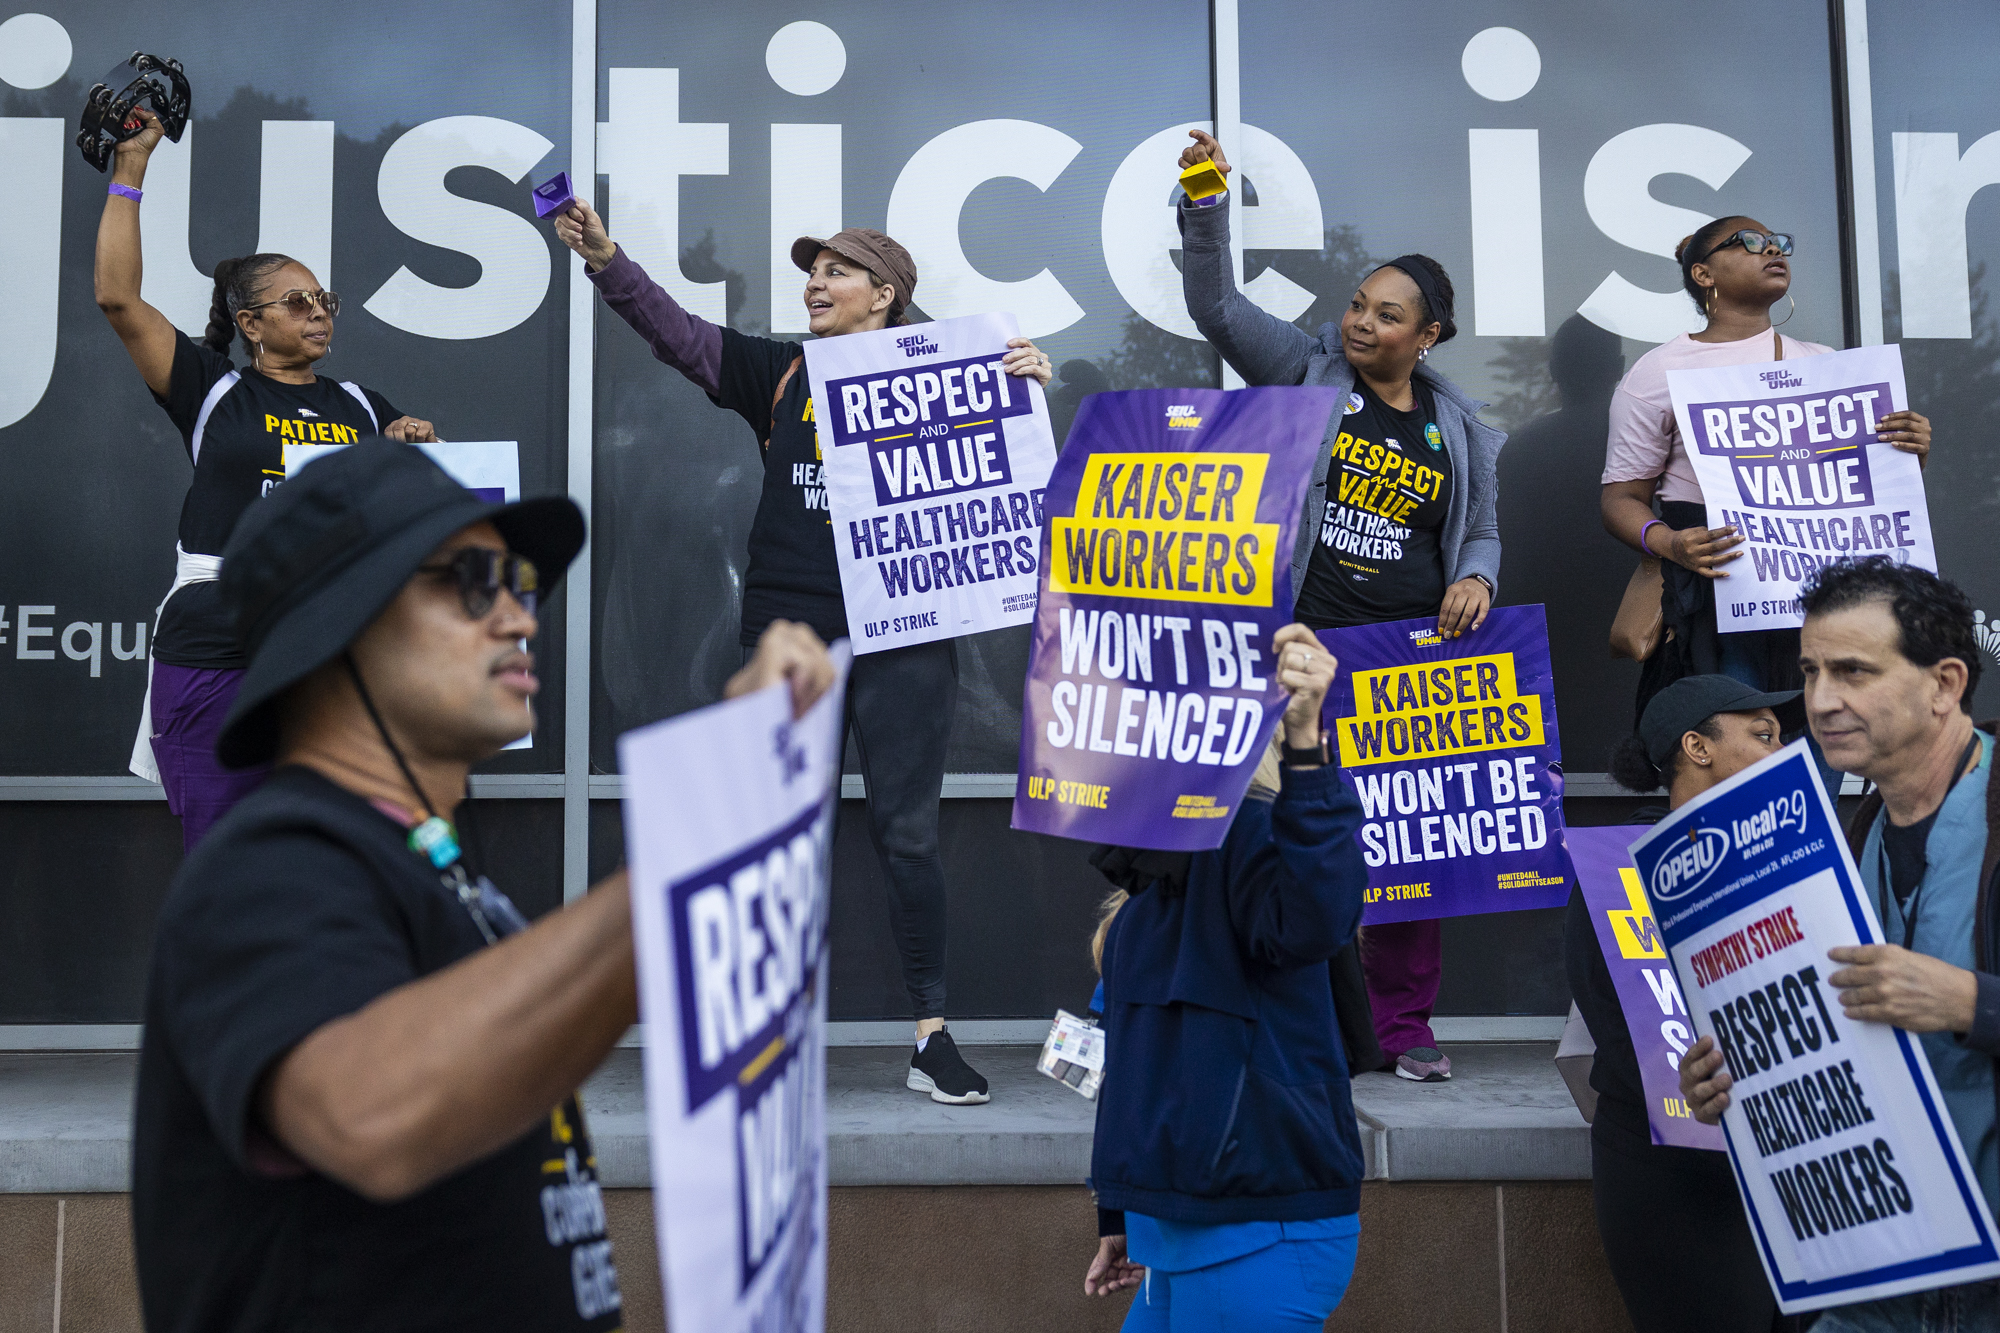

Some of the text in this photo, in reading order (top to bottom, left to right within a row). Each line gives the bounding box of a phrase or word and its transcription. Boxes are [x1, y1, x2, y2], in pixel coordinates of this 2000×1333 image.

[0, 13, 1324, 429] justice
[1461, 26, 1753, 343] is
[896, 334, 928, 349] SEIU-
[905, 343, 938, 358] UHW
[841, 360, 1011, 434] RESPECT
[1759, 370, 1792, 382] SEIU-
[1768, 377, 1803, 390] UHW
[265, 413, 359, 444] PATIENT
[919, 423, 949, 439] AND
[1165, 405, 1196, 417] SEIU-
[1168, 416, 1202, 428] UHW
[1702, 390, 1880, 449] RESPECT
[876, 432, 1003, 498] VALUE
[1331, 432, 1444, 501] RESPECT
[1780, 448, 1810, 461] AND
[1092, 462, 1243, 523] KAISER
[1338, 472, 1418, 524] VALUE
[1371, 475, 1399, 490] and
[1737, 457, 1866, 506] VALUE
[849, 488, 1047, 559] HEALTHCARE
[1320, 523, 1403, 560] WORKERS
[1324, 500, 1412, 541] EALTHCARE
[1721, 510, 1916, 552] HEALTHCARE
[878, 536, 1037, 599] WORKERS
[1064, 527, 1259, 596] WORKERS
[864, 611, 938, 638] ULP STRIKE
[1409, 629, 1435, 640] SEIU-
[1731, 602, 1757, 618] ULP
[0, 605, 160, 678] Equ
[1059, 607, 1267, 692] WON'T BE
[1416, 636, 1442, 646] UHW
[1369, 661, 1501, 714] KAISER
[1046, 681, 1264, 766] SILENCED
[1349, 702, 1531, 760] WORKERS
[1028, 776, 1111, 810] ULP STRIKE
[1354, 756, 1541, 819] WON'T BE
[1361, 805, 1547, 868] SILENCED
[1732, 789, 1807, 850] Local 29
[1497, 871, 1540, 882] #UNITED4ALL
[1498, 876, 1564, 890] #SOLIDARITYSEASON
[1659, 835, 1715, 894] OPEIU
[1386, 882, 1432, 901] STRIKE
[1690, 929, 1753, 989] SYMPATHY
[1747, 905, 1805, 961] STRIKE
[1709, 964, 1840, 1083] RESPECT
[1741, 1059, 1875, 1158] HEALTHCARE
[1769, 1137, 1914, 1242] WORKERS
